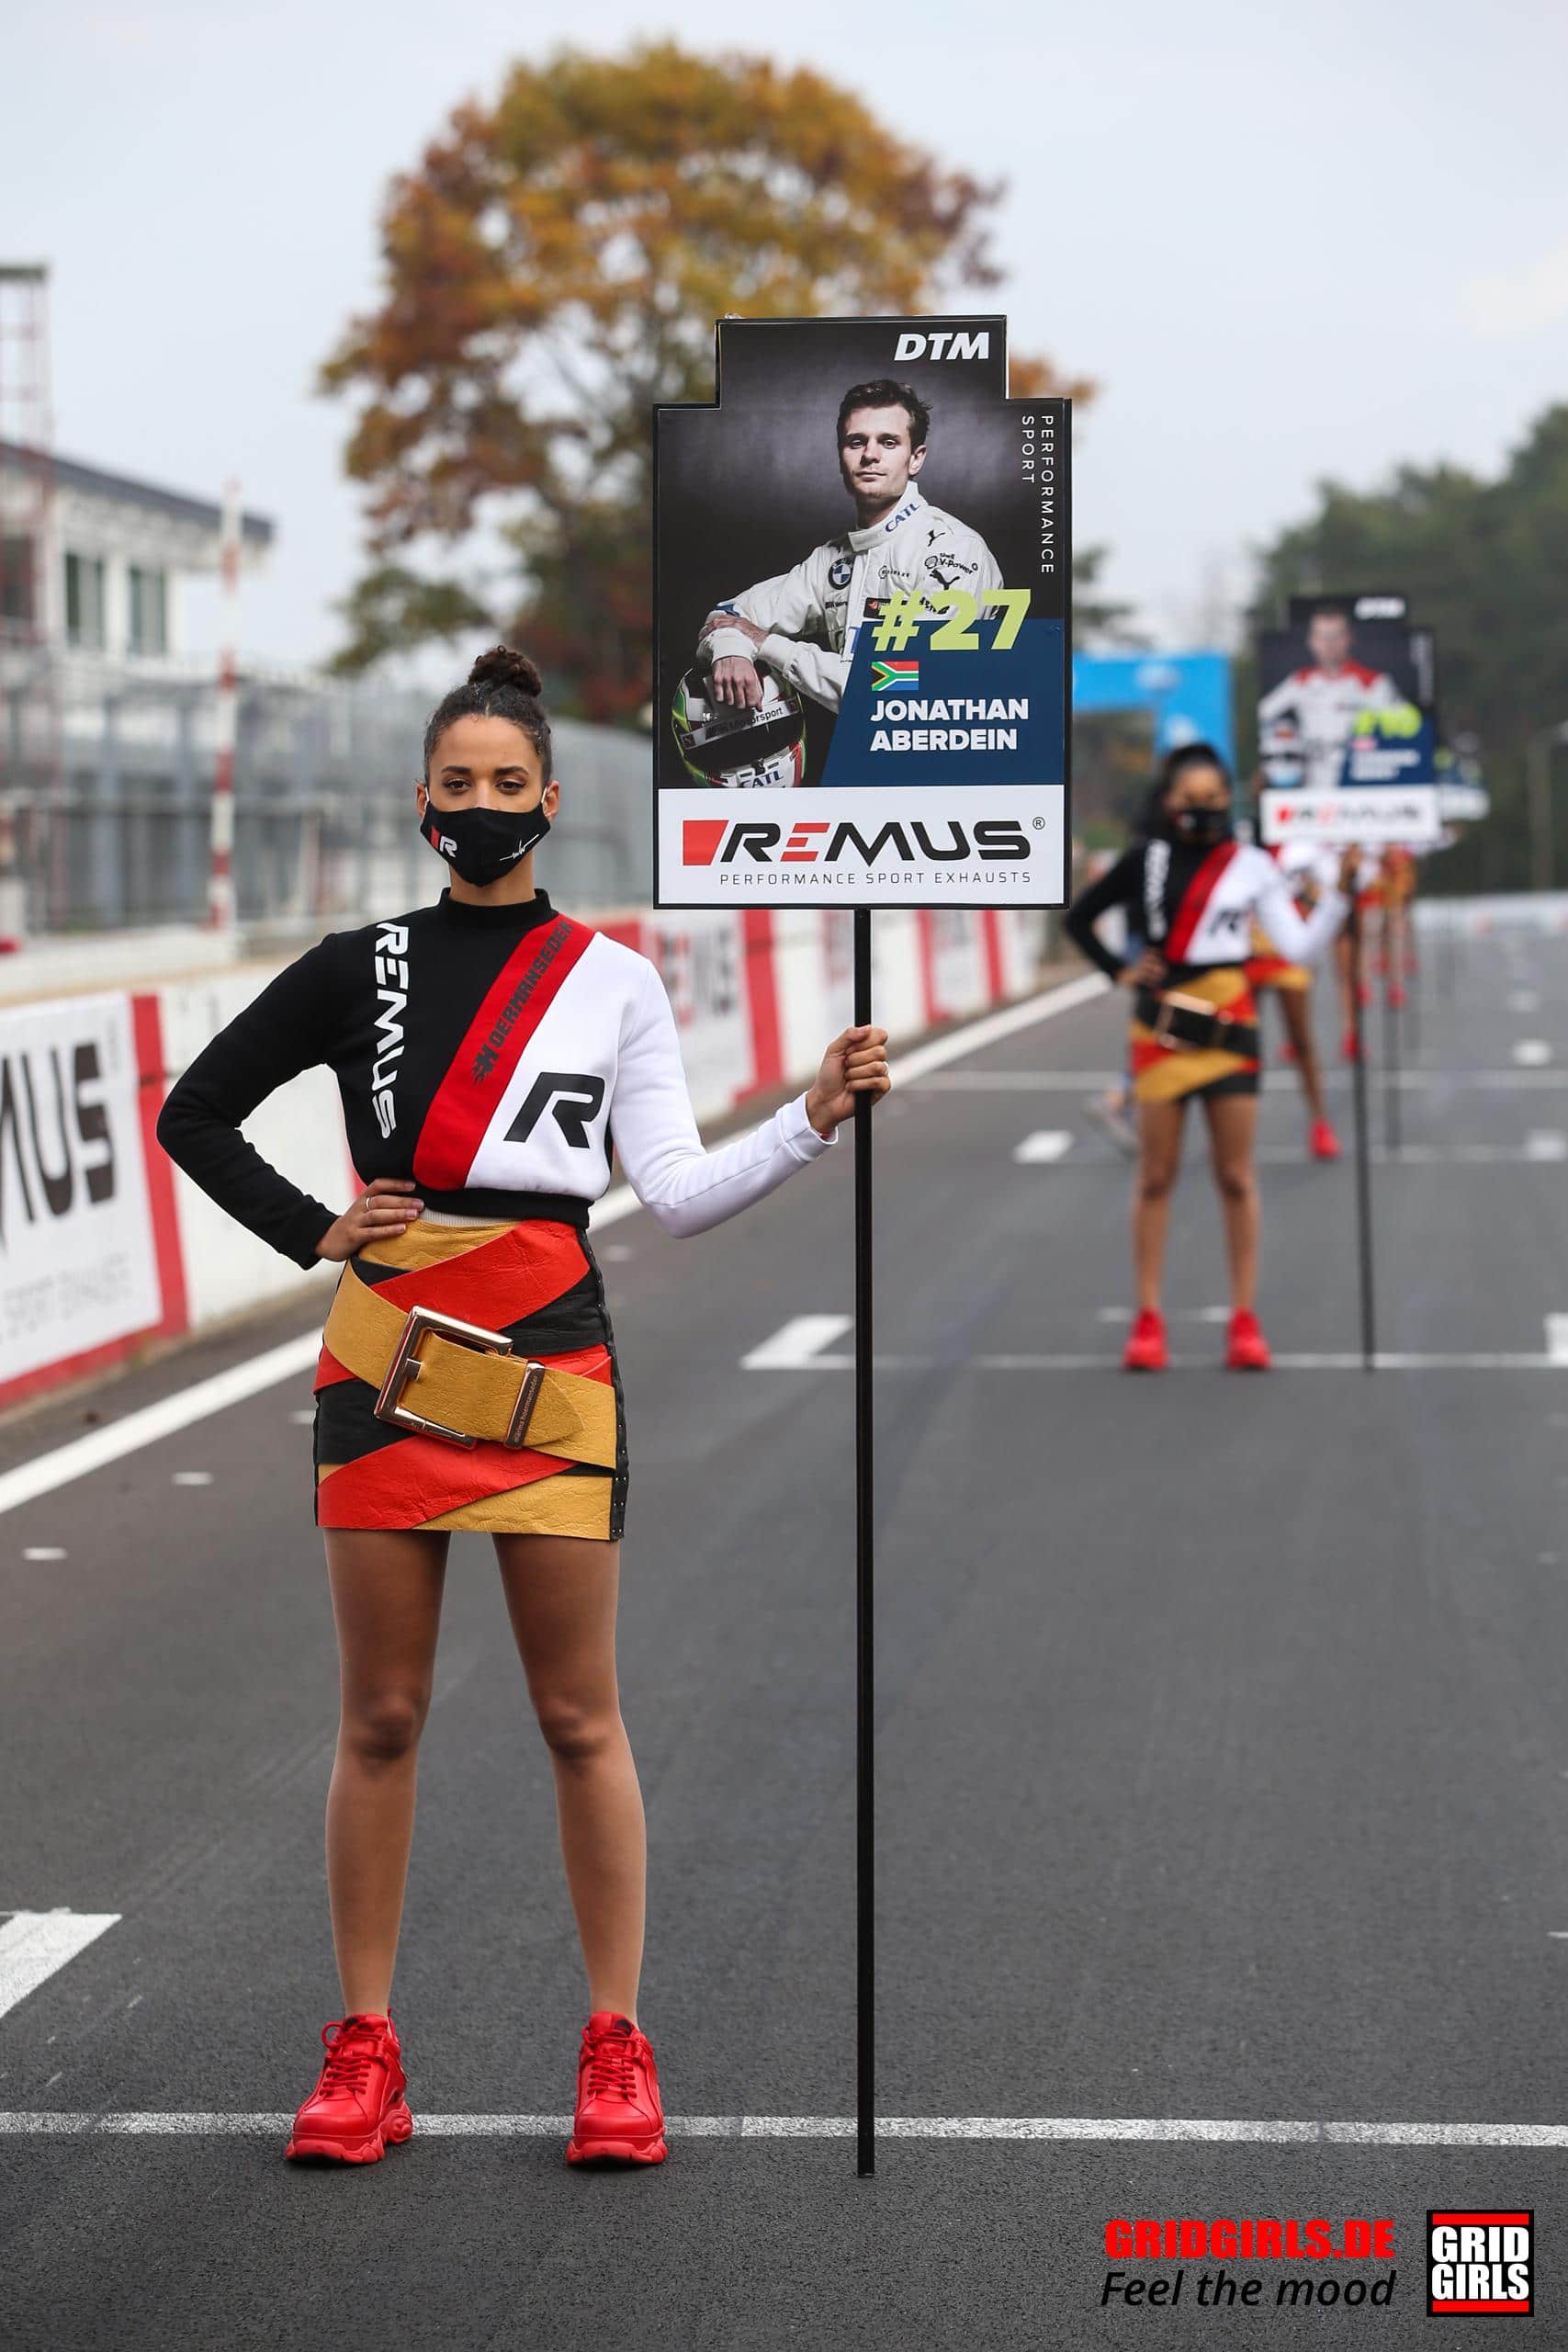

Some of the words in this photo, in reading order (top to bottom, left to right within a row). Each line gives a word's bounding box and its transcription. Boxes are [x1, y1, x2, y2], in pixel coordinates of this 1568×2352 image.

[895, 333, 989, 361] DTM
[1021, 415, 1035, 483] SPORT
[1041, 415, 1055, 573] PERFORMANCE
[872, 589, 1031, 651] #27
[870, 698, 1029, 721] JONATHAN
[870, 729, 1018, 751] ABERDEIN
[439, 835, 457, 858] R
[720, 820, 1031, 866] REMUS
[721, 873, 855, 885] PERFORMANCE
[866, 872, 924, 884] SPORT
[934, 871, 1031, 883] EXHAUSTS
[372, 922, 410, 1139] REMUS
[503, 1071, 605, 1148] R
